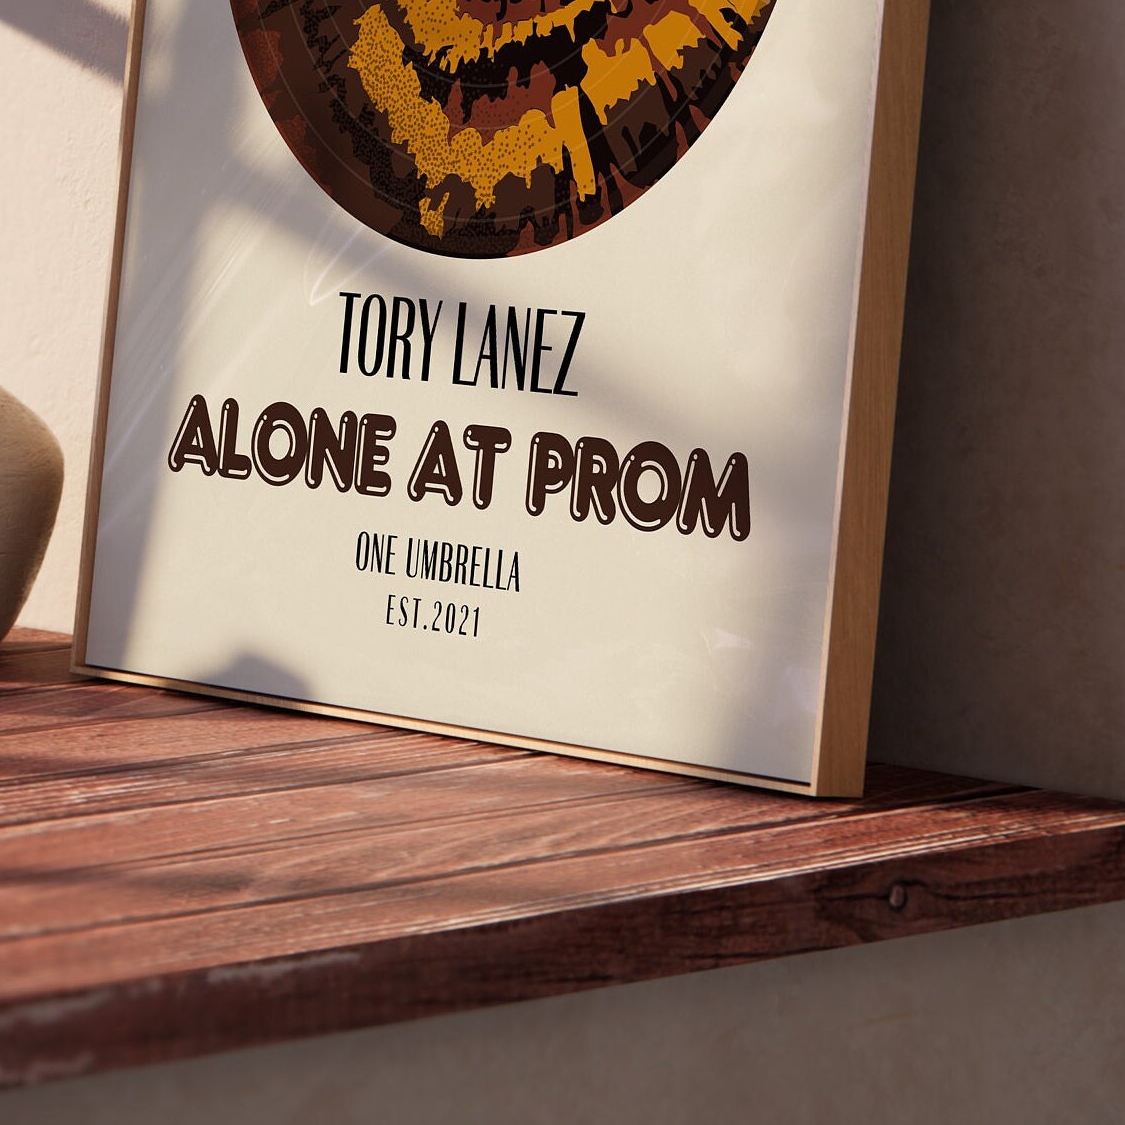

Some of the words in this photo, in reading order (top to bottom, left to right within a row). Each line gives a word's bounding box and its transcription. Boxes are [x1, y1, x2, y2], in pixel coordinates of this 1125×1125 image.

[338, 291, 444, 382] TORY
[451, 301, 587, 397] LANEZ
[167, 394, 398, 498] ALONE
[406, 419, 513, 511] AT
[525, 431, 751, 542] PROM
[355, 531, 398, 575] ONE
[405, 537, 521, 593] UMBRELLA
[385, 594, 481, 638] EST.2021
